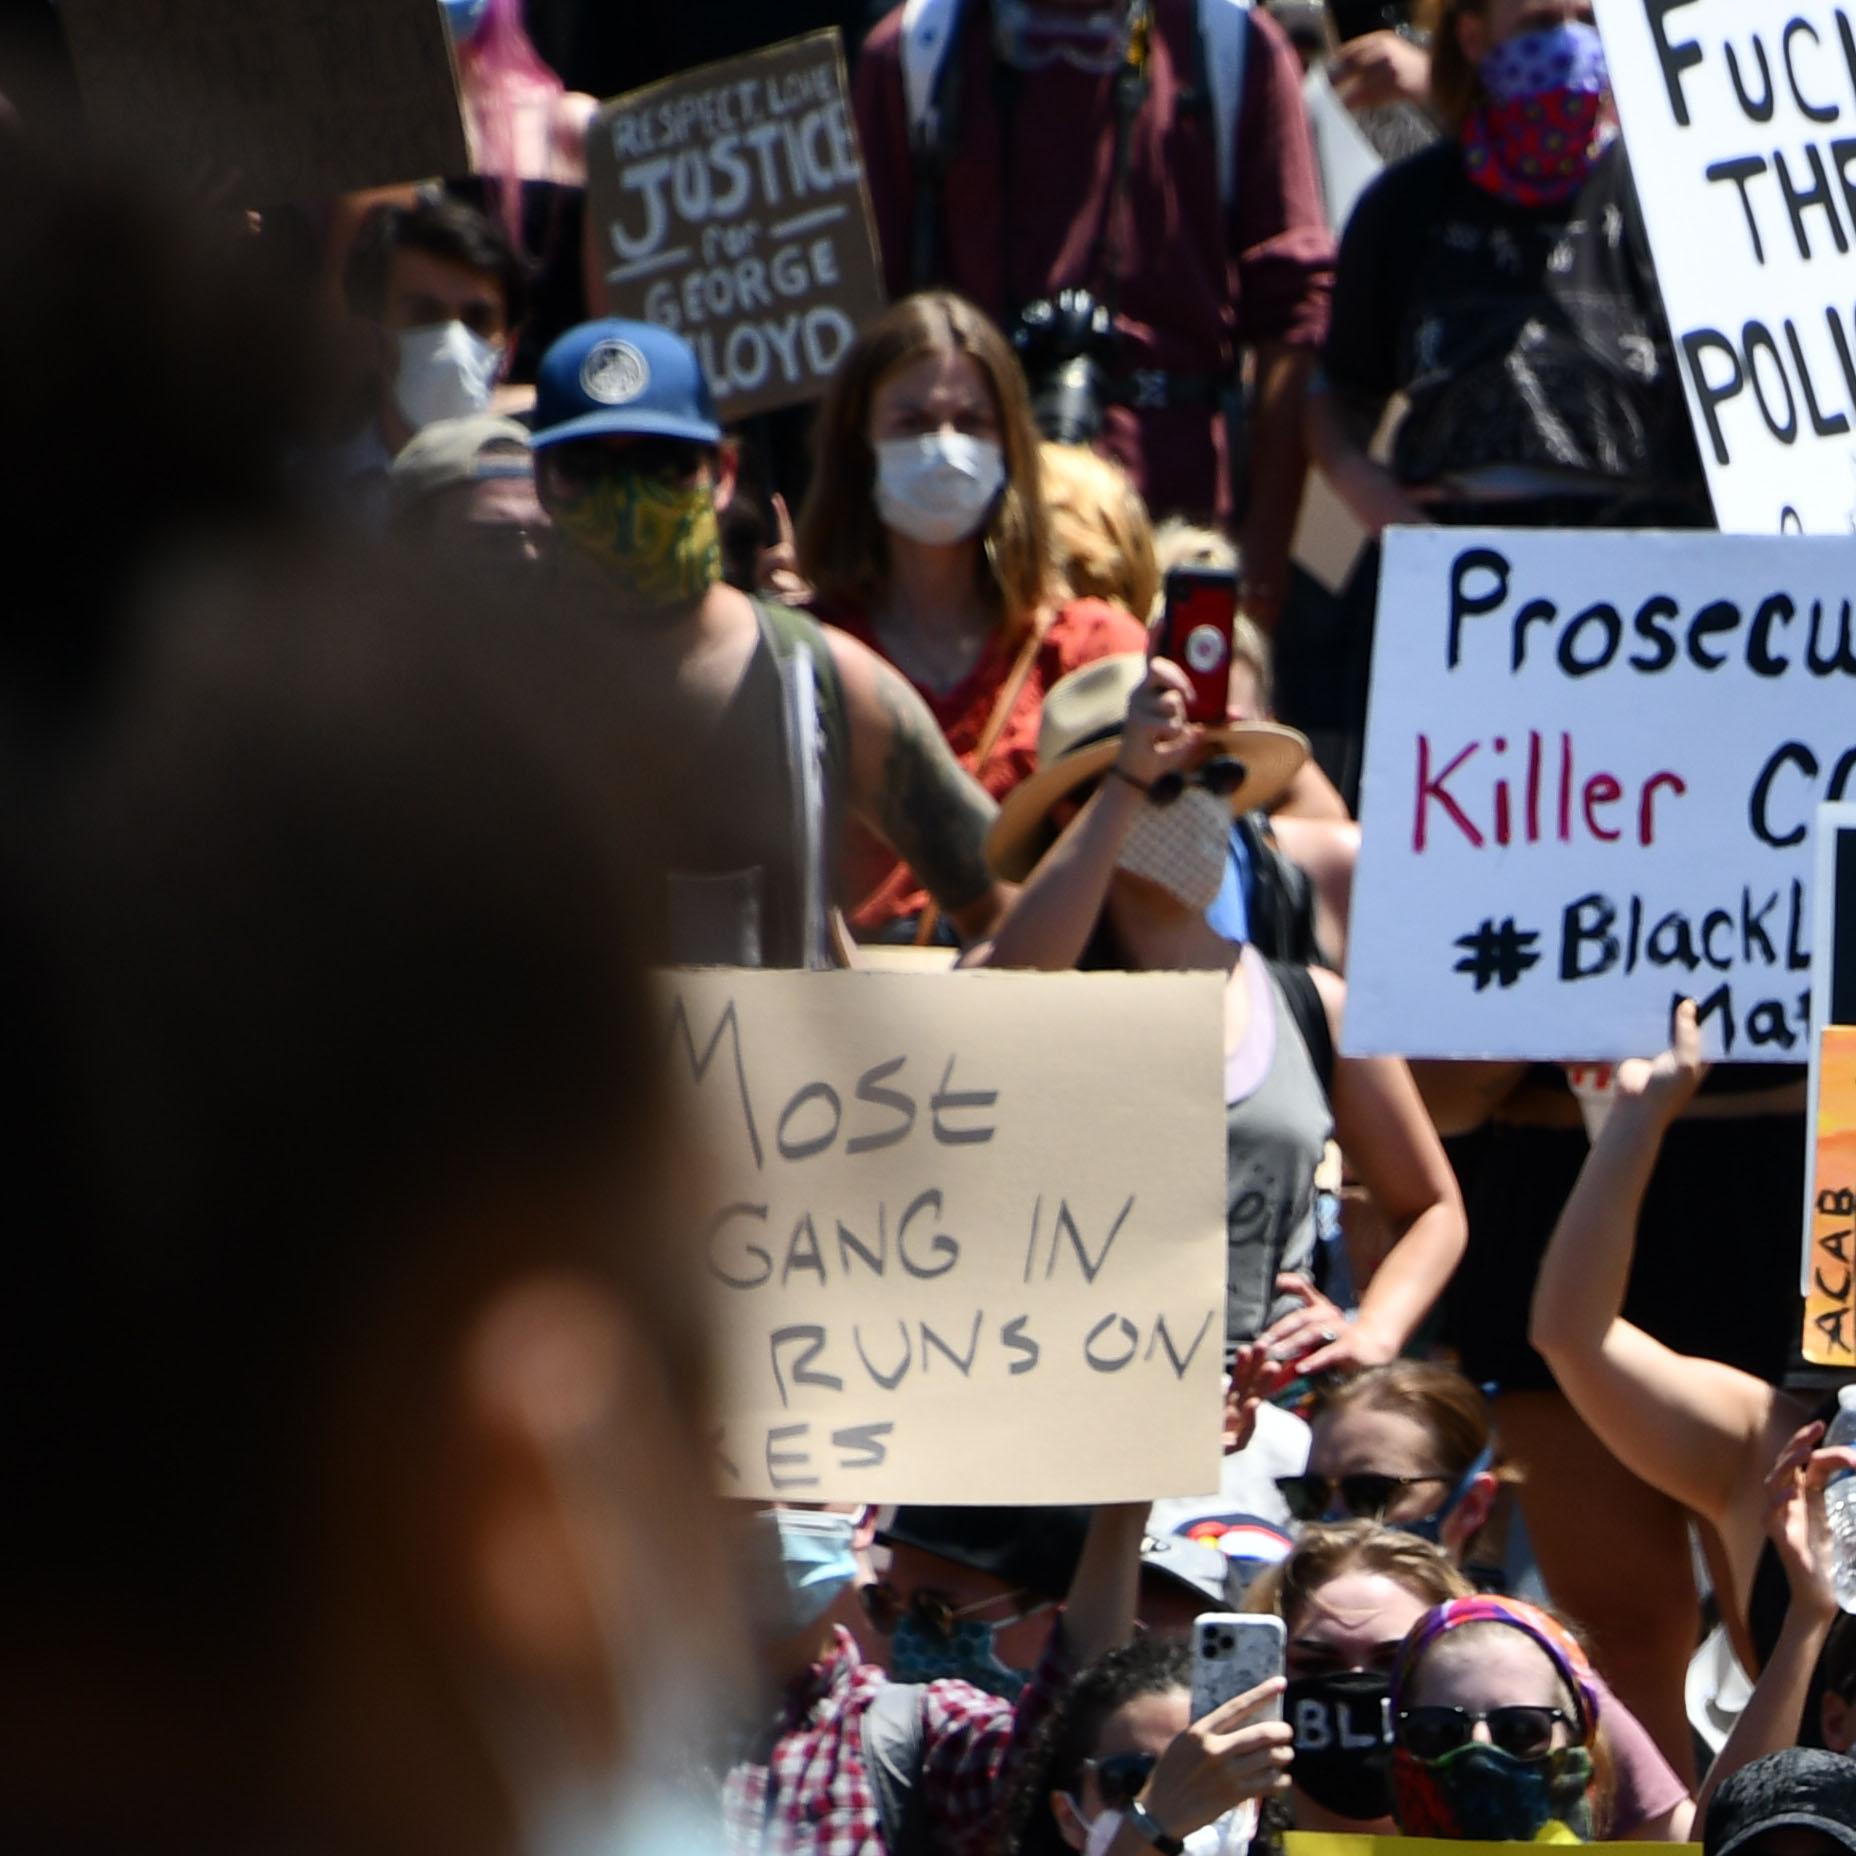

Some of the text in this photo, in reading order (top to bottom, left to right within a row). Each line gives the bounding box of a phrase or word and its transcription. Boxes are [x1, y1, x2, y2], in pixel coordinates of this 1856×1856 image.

[609, 101, 862, 263] JUSTICE
[644, 239, 839, 332] GEORGE
[686, 305, 855, 397] LOYD
[1411, 729, 1687, 854] Killer
[707, 1189, 1136, 1290] GANG IN
[1811, 1185, 1855, 1356] ACAB
[770, 1310, 1217, 1408] RUNS ON
